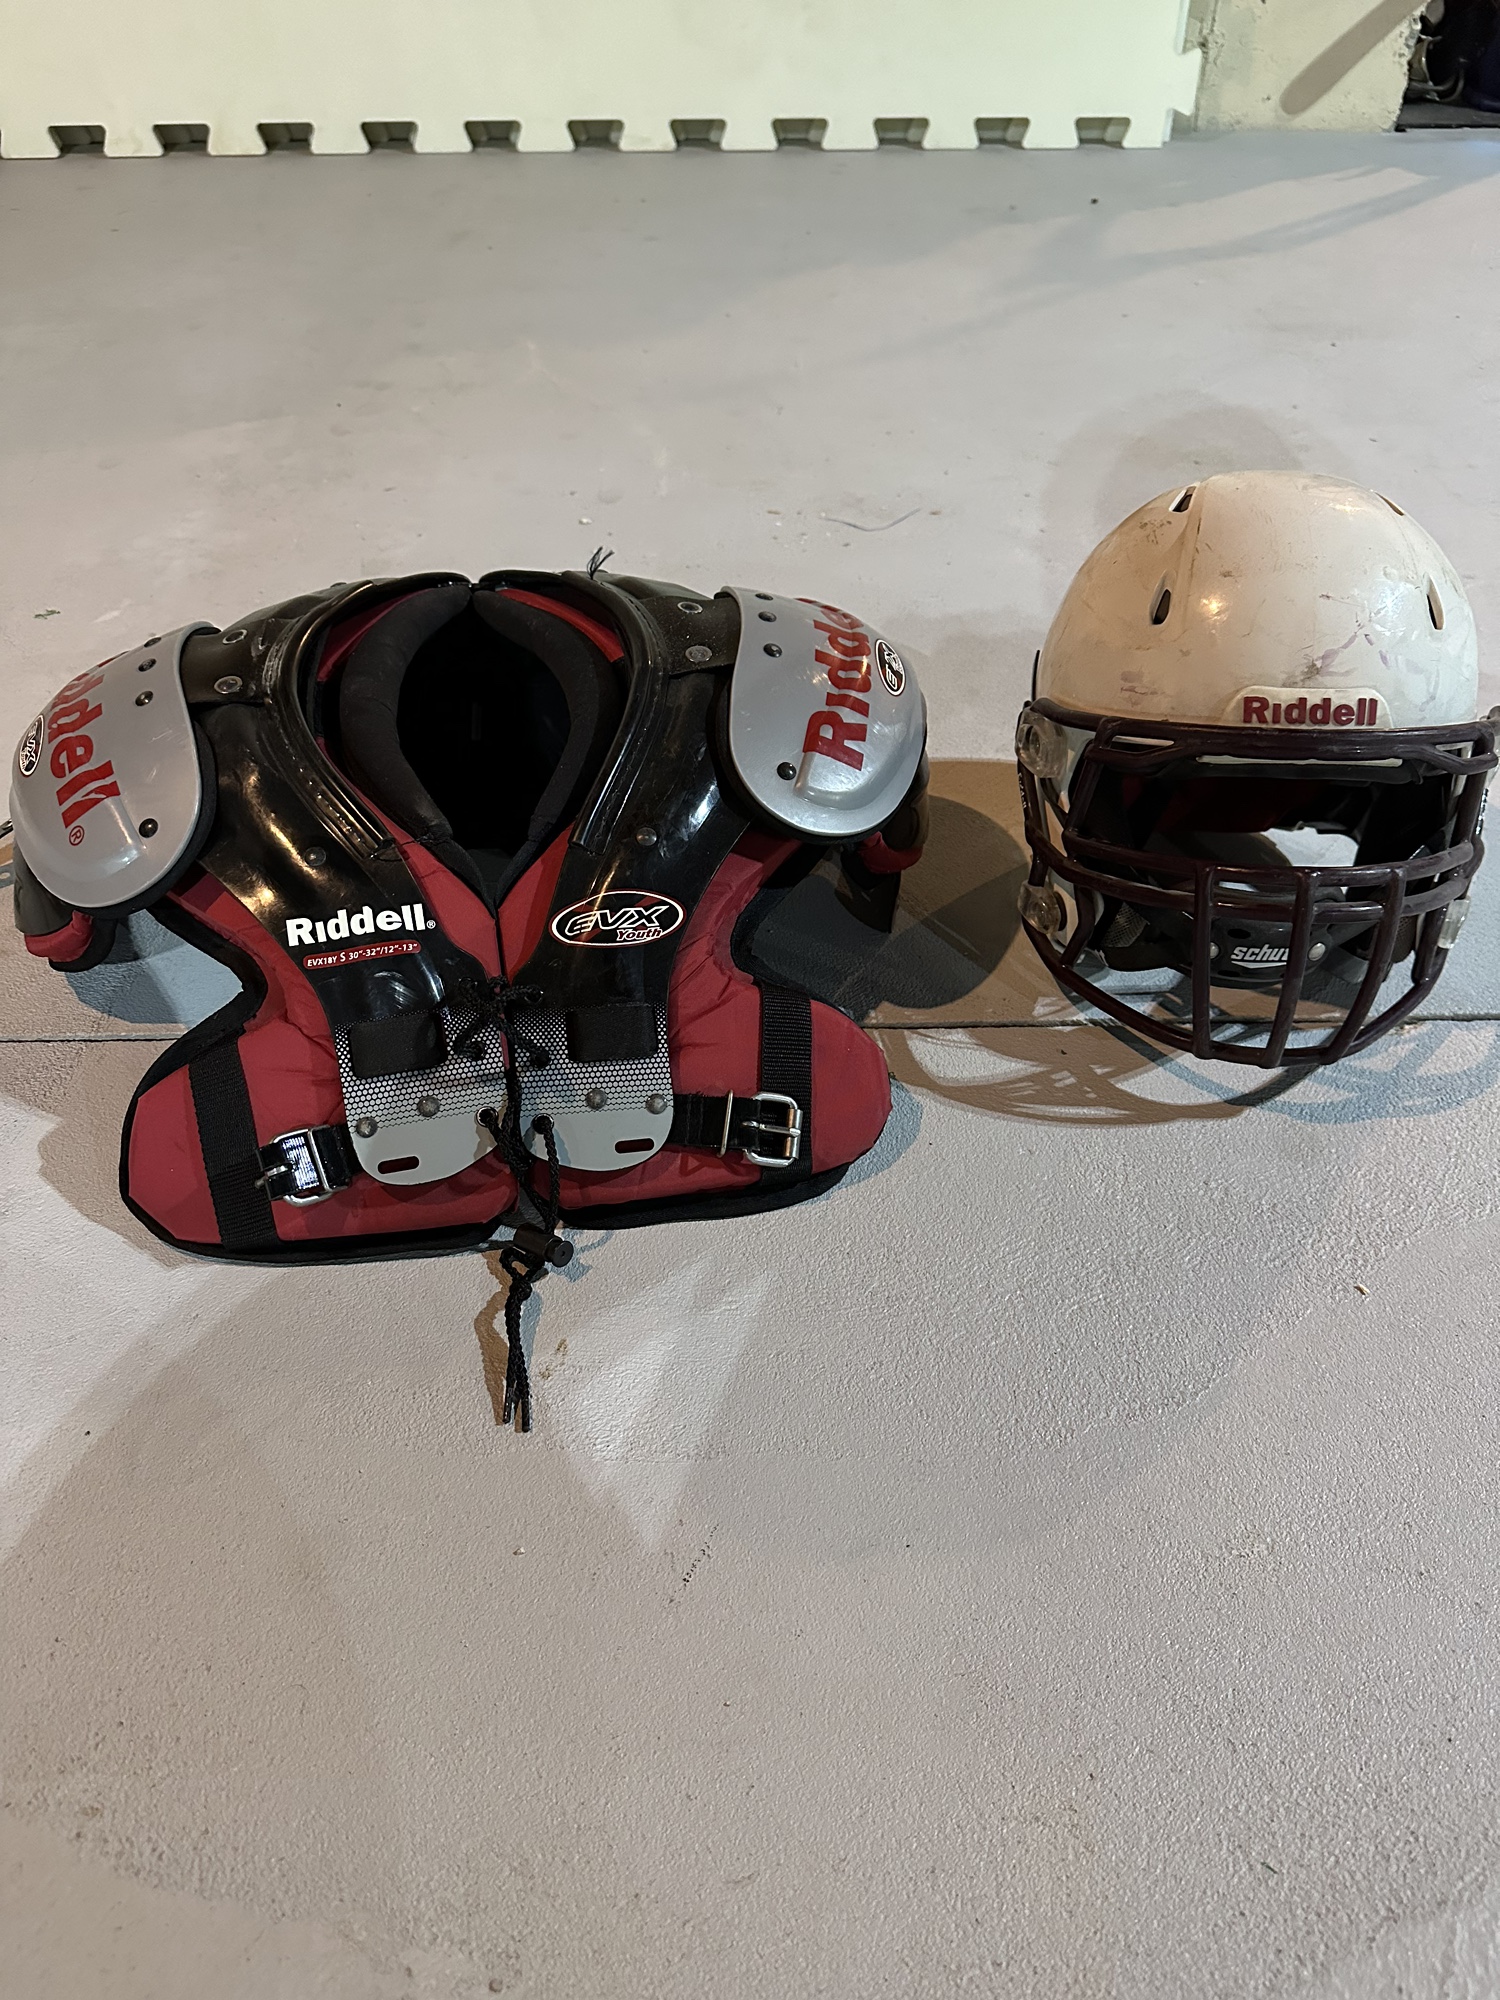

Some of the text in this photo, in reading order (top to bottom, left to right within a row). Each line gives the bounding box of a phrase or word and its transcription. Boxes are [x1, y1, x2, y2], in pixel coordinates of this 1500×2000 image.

[1243, 696, 1378, 726] Riddell
[565, 905, 670, 936] EVX
[616, 926, 663, 941] Youth
[307, 956, 338, 967] EVX18Y
[339, 952, 346, 962] S
[1230, 944, 1290, 961] schu
